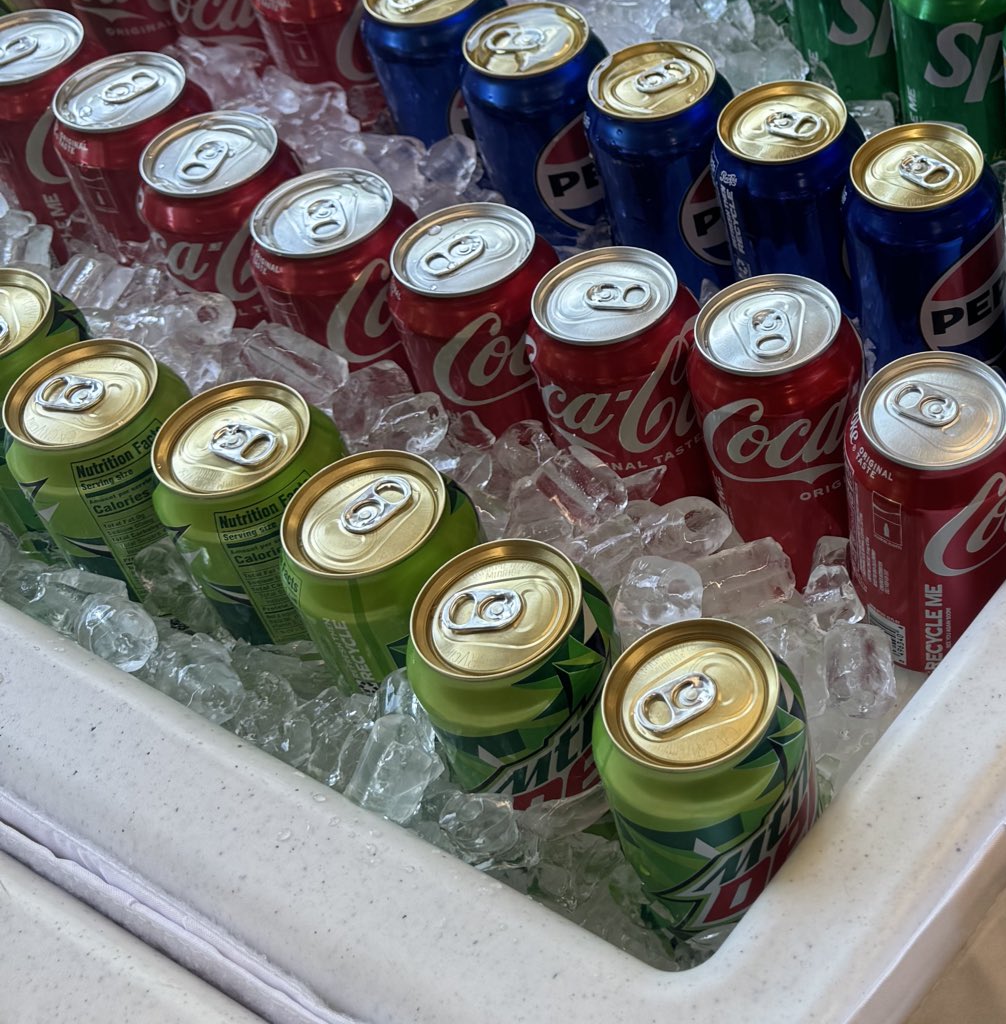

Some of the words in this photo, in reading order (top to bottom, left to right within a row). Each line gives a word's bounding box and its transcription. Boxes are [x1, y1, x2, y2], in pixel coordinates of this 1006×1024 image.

[75, 449, 135, 479] Nutrition
[855, 451, 877, 479] TASTE
[859, 446, 894, 482] ORIGINAL
[93, 489, 151, 515] Calories
[219, 502, 279, 529] Nutrition
[223, 528, 258, 542] Serving
[924, 583, 943, 607] ME
[332, 618, 376, 682] RECYCLE
